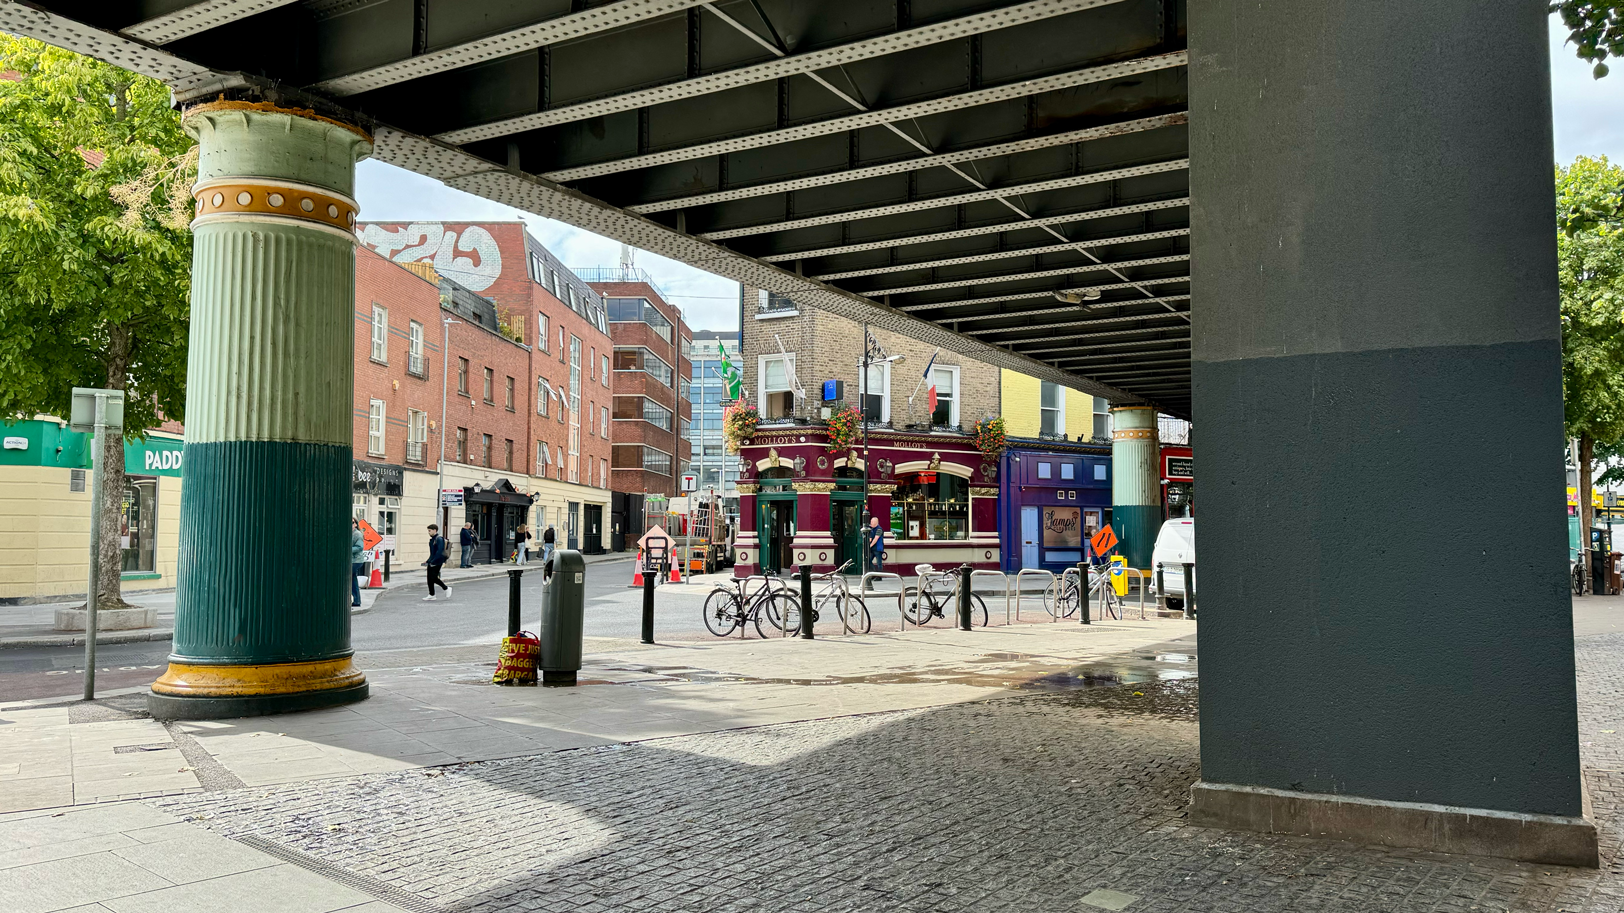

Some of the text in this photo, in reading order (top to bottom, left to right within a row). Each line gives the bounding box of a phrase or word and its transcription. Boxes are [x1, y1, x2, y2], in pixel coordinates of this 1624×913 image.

[754, 436, 796, 445] MOLLOY'S
[145, 450, 184, 470] PADD
[377, 468, 399, 477] DESIGNS
[502, 669, 536, 680] BARGAI
